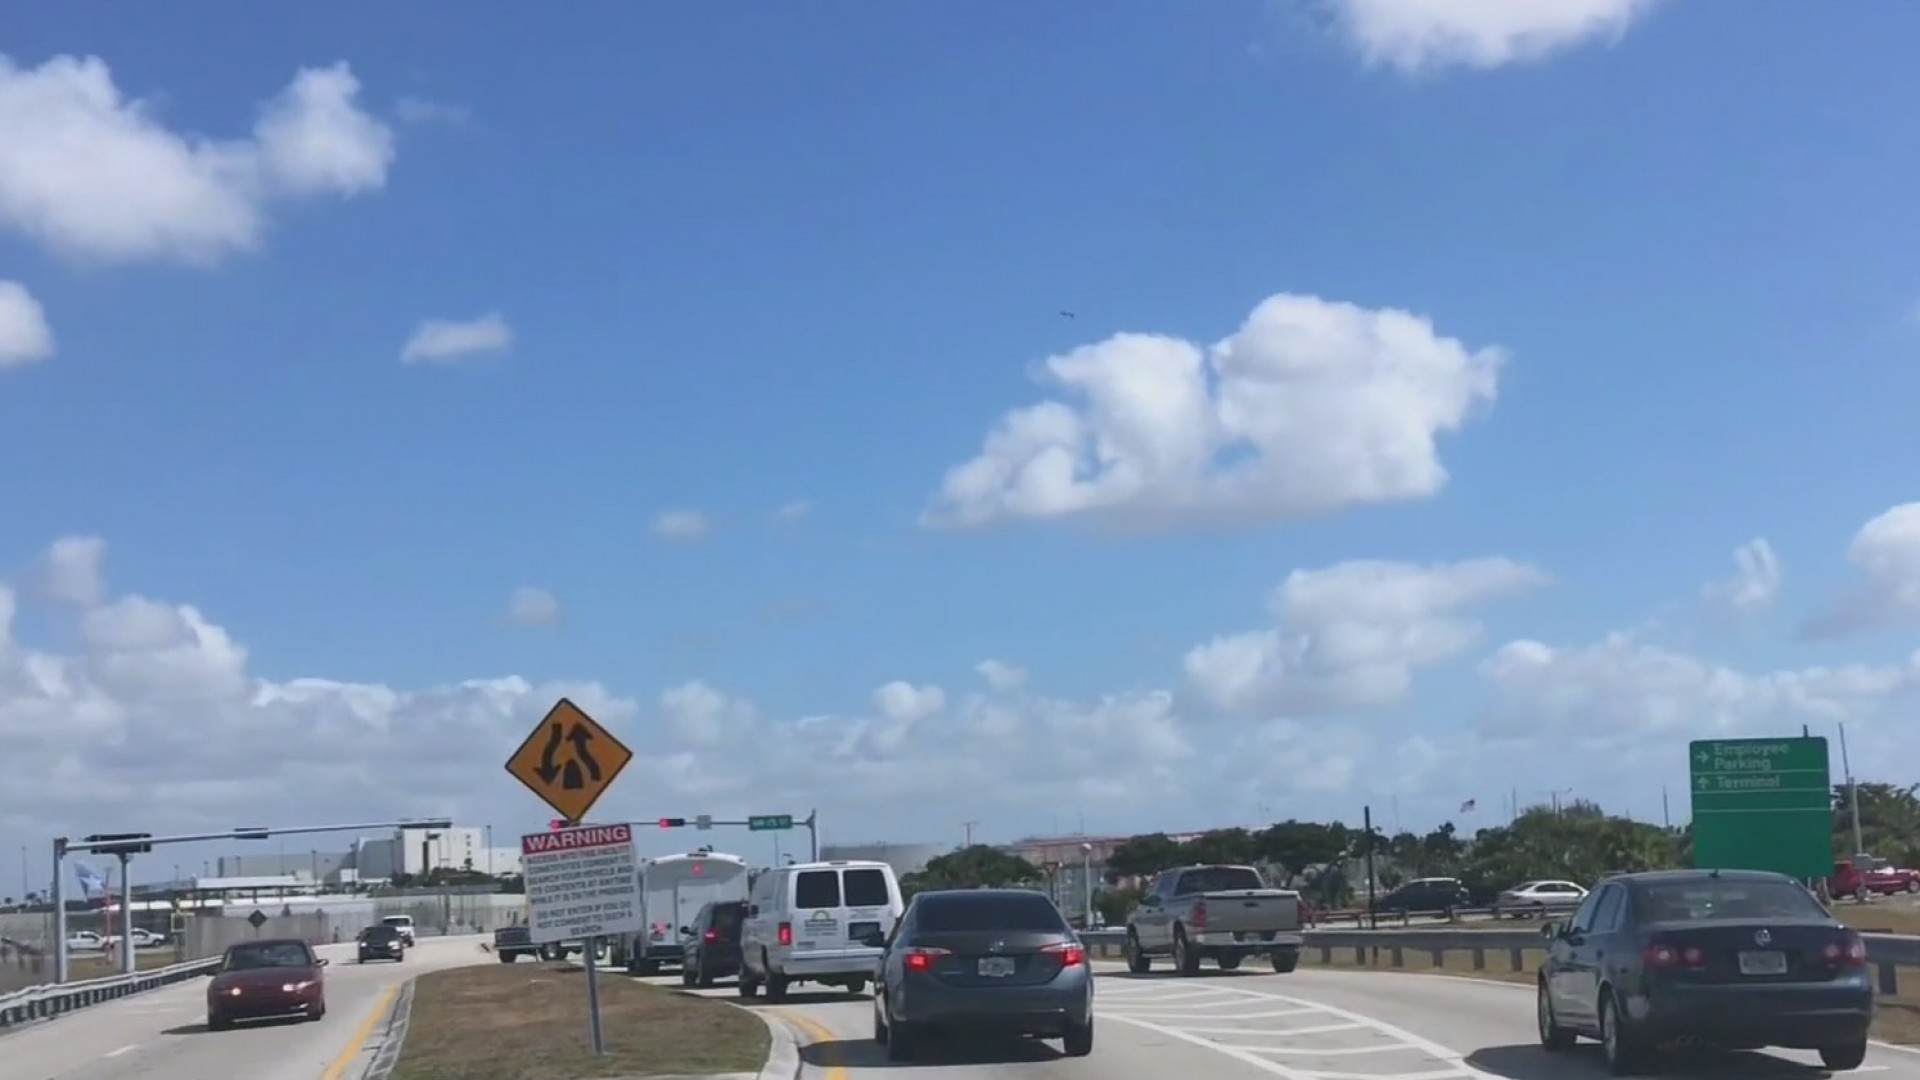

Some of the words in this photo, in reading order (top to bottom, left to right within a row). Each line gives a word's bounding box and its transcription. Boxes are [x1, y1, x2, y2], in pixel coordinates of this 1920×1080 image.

[1713, 743, 1789, 756] Employee
[1714, 757, 1771, 771] Parking
[1716, 775, 1781, 789] Terminal
[526, 826, 628, 851] WARNING
